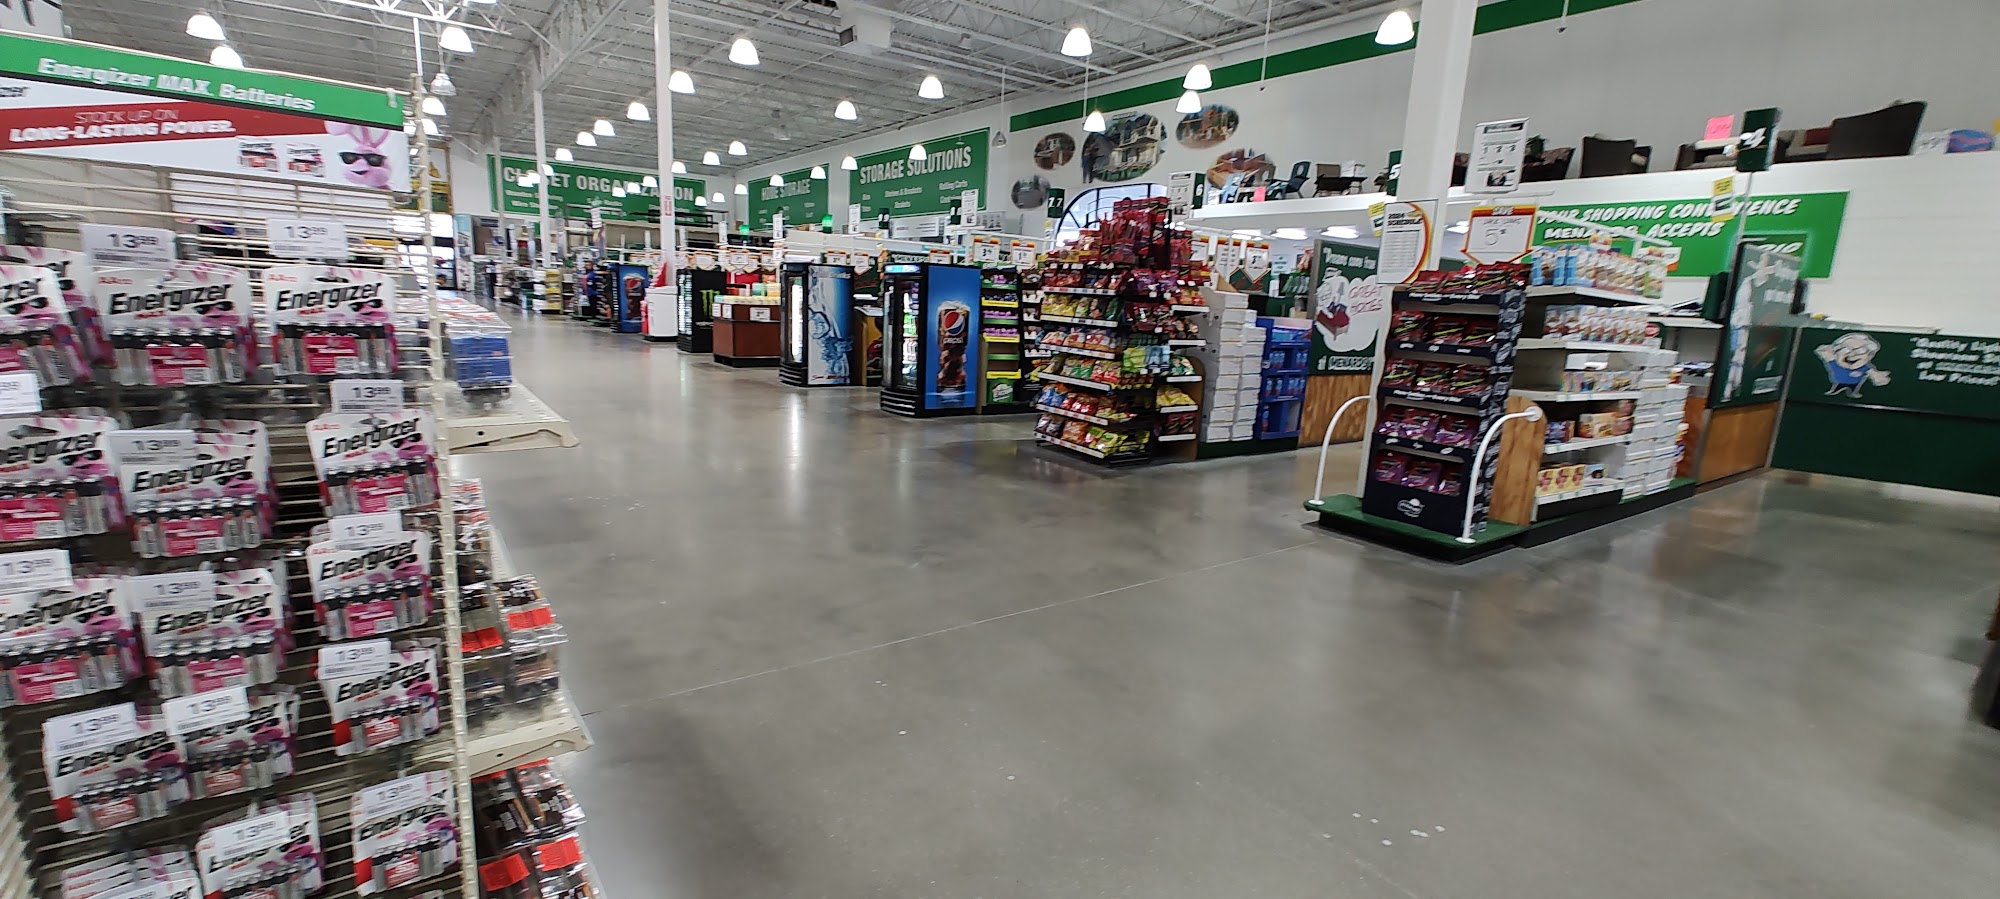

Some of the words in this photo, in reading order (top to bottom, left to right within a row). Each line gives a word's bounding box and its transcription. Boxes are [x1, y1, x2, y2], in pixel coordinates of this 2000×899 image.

[38, 58, 154, 87] Energizer
[219, 83, 316, 111] Batteries
[9, 123, 158, 143] LONG-LASTING
[127, 111, 153, 122] UP
[153, 109, 180, 120] ON
[860, 160, 905, 184] STORAGE
[907, 146, 972, 177] SOLUTIONS
[1195, 184, 1204, 196] 6
[1581, 204, 1667, 222] SHOPPING
[1646, 222, 1726, 240] ACCEPTS
[108, 283, 233, 315] Energizer
[276, 281, 382, 311] Energizer
[323, 418, 420, 458] Energizer
[132, 455, 253, 493] Energizer
[321, 540, 417, 581] Energizer
[336, 658, 430, 704] Energizer
[359, 802, 446, 842] Energizer
